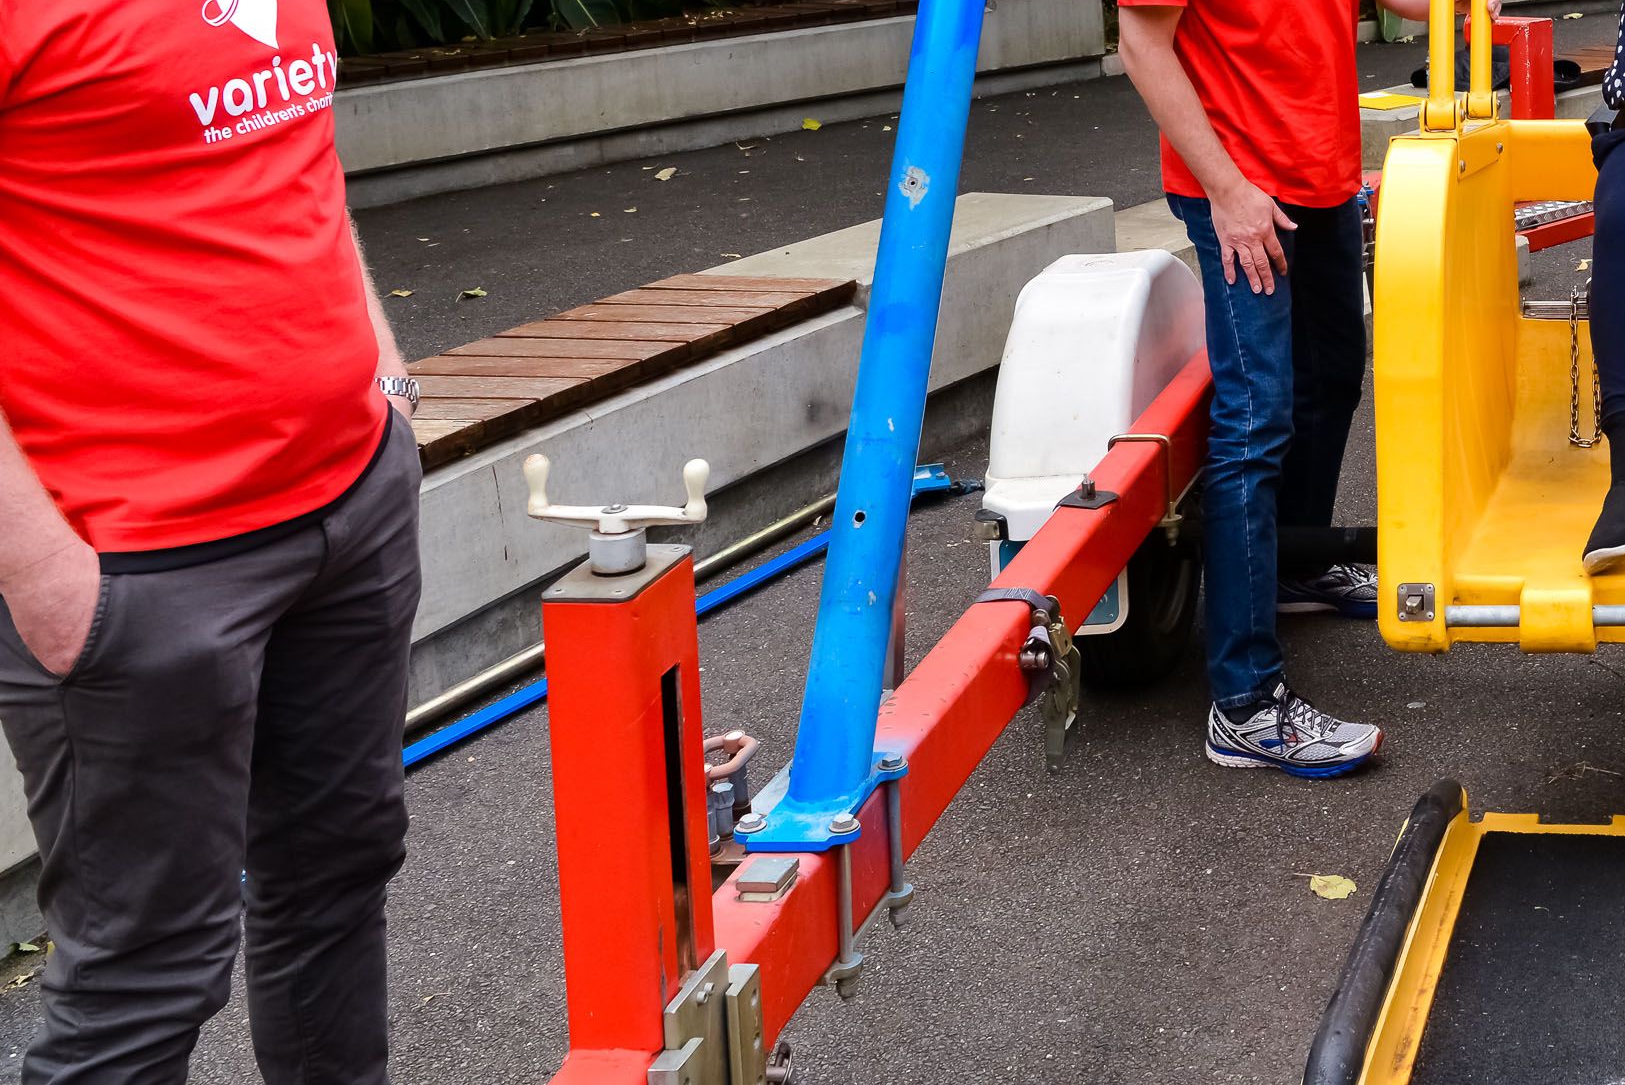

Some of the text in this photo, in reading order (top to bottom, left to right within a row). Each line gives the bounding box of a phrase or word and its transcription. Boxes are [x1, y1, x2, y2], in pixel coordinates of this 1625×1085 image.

[204, 92, 334, 144] the children's charit
